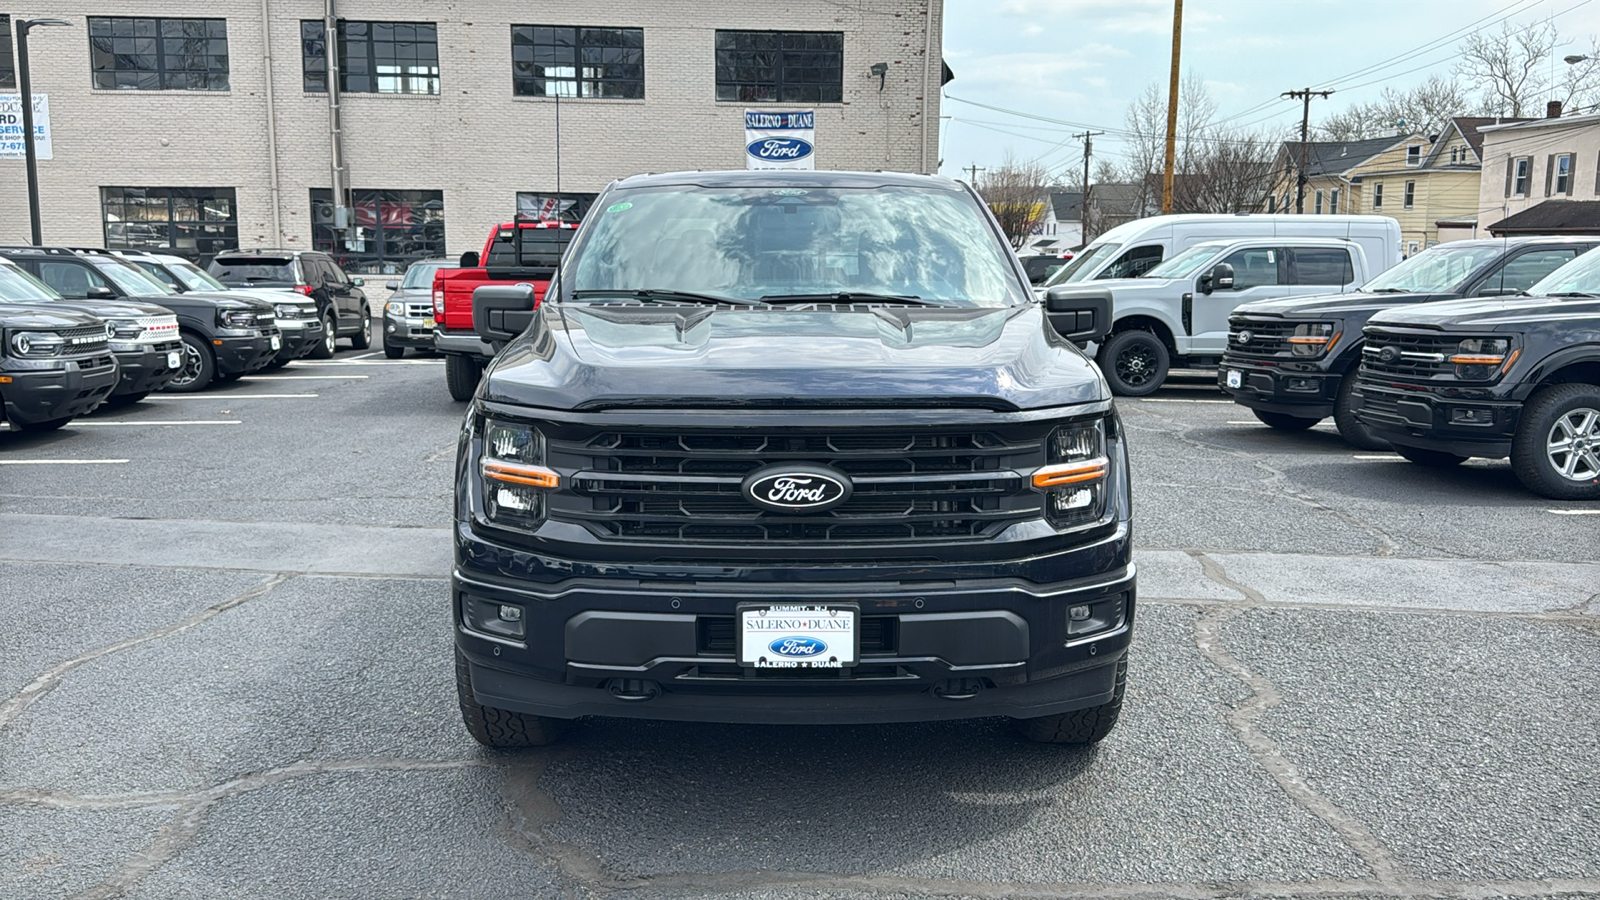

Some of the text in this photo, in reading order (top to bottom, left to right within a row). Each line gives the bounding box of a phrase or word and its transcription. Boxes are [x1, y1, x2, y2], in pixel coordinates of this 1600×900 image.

[746, 113, 813, 128] SALERNO DUANE
[0, 126, 45, 134] SERVCE
[760, 140, 801, 157] Ford
[72, 335, 107, 345] BRONCO
[768, 477, 826, 502] Ford
[746, 619, 851, 630] SALERNO DUANE
[780, 638, 816, 655] Ford
